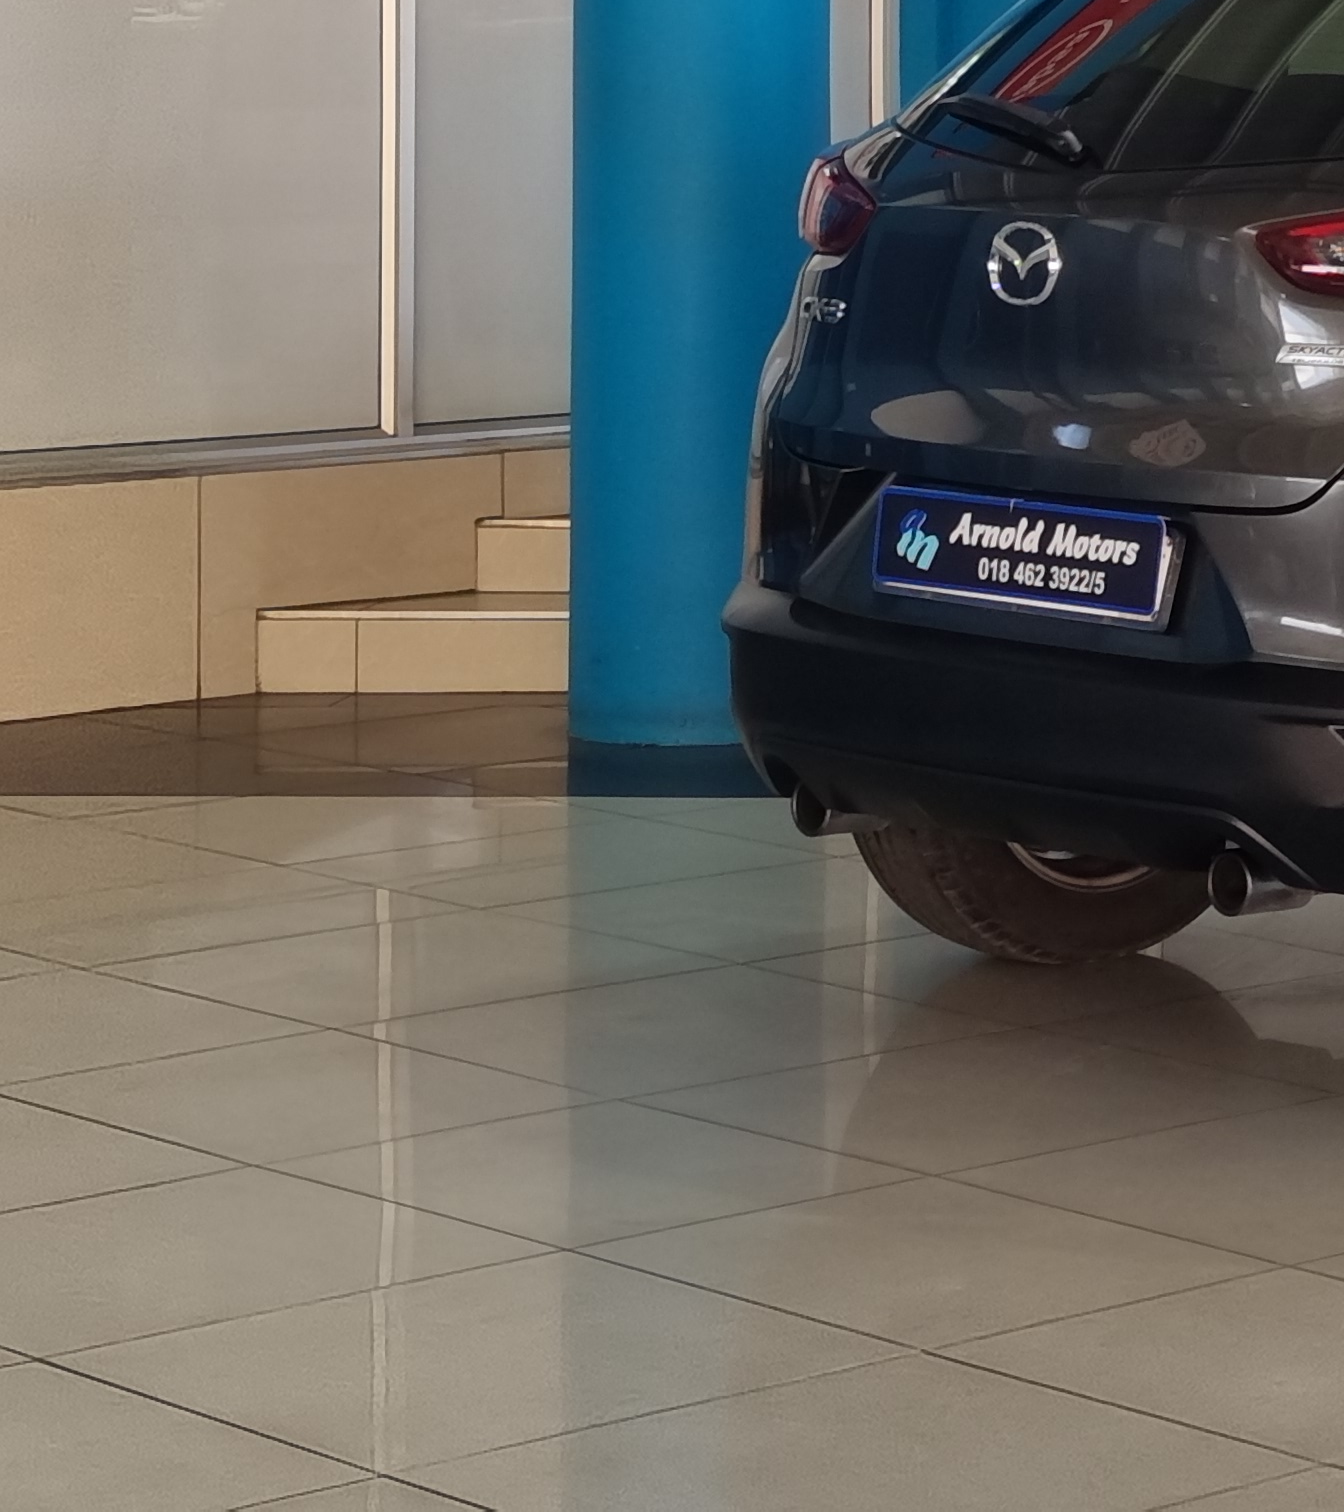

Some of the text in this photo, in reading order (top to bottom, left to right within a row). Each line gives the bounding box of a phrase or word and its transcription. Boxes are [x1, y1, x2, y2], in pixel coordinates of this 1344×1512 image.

[949, 512, 1141, 566] Arnold Motors
[977, 557, 1106, 595] 018 462 3922/5
